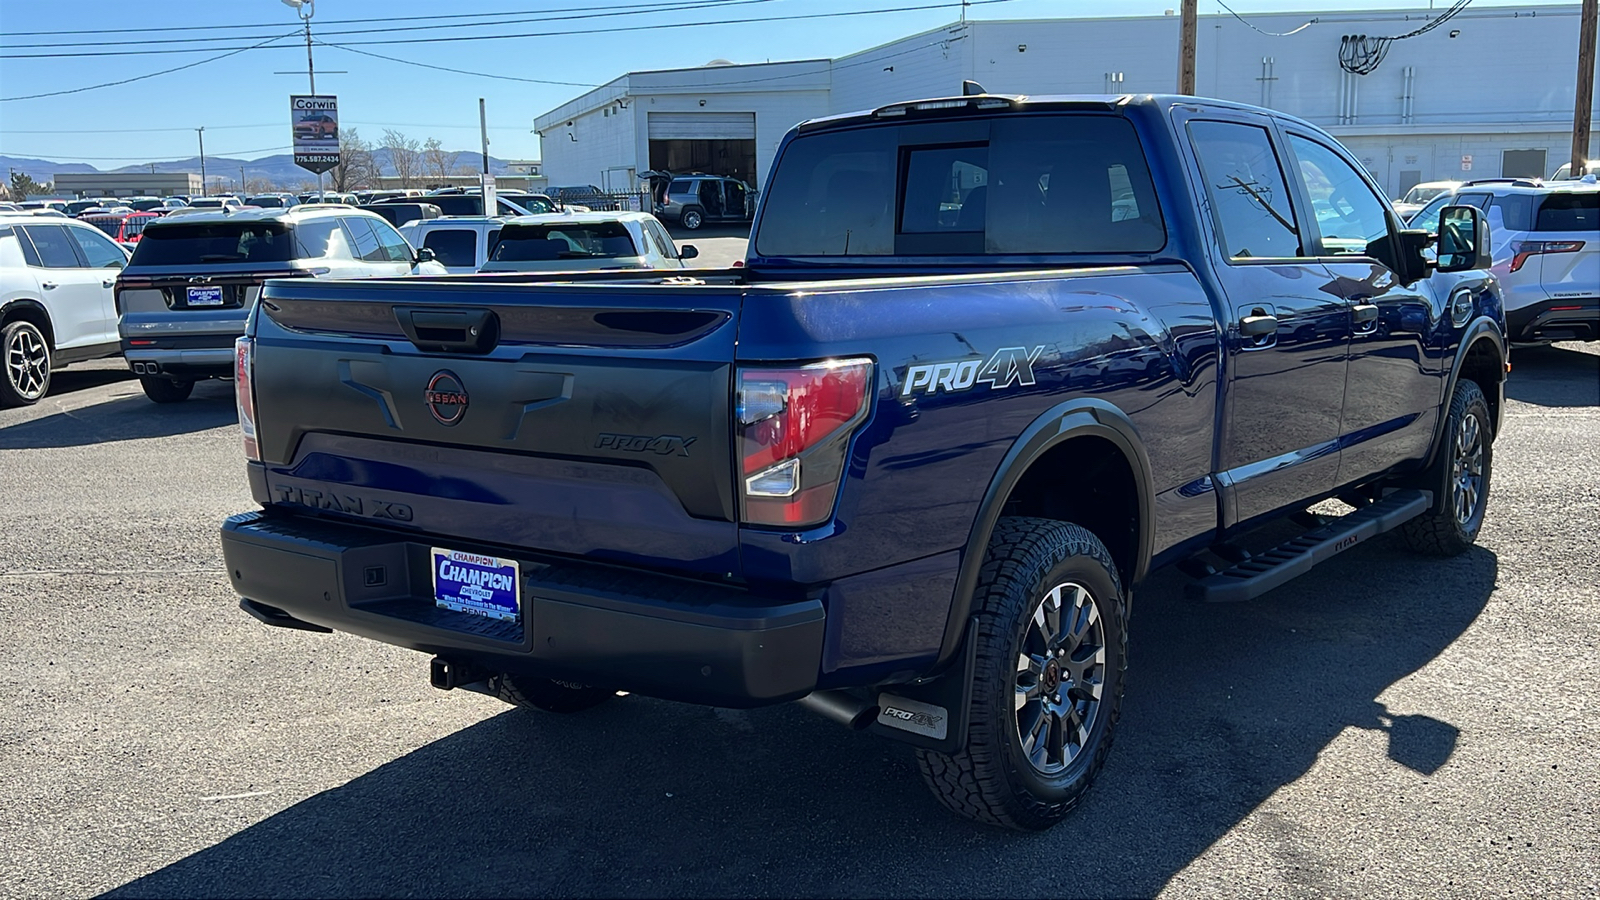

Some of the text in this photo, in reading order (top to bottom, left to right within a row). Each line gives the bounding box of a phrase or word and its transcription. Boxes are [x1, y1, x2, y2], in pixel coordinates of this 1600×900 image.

[296, 99, 336, 109] Corwin
[425, 391, 467, 405] NISSAN
[274, 484, 414, 522] TITAN XD
[453, 552, 494, 566] CHAMPION
[439, 560, 513, 592] CHAMPION
[461, 587, 491, 598] CHEVROLET
